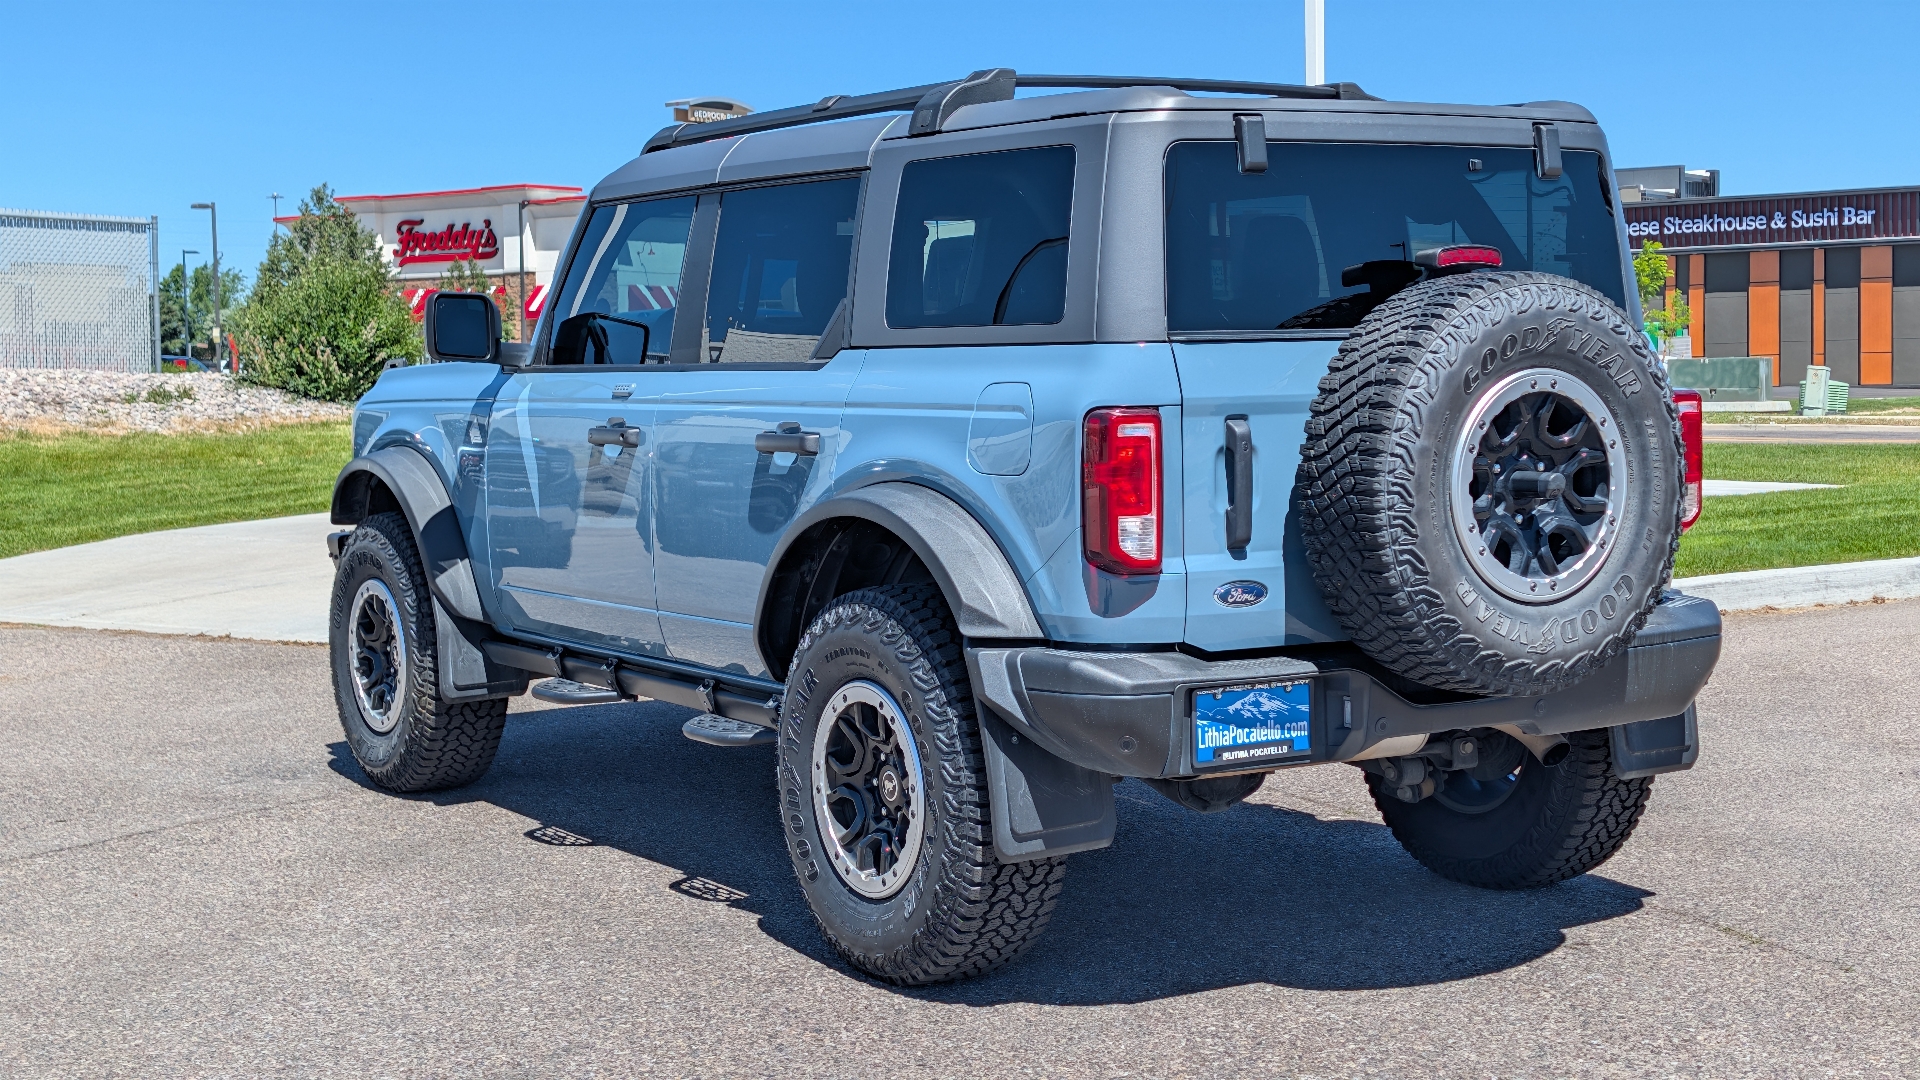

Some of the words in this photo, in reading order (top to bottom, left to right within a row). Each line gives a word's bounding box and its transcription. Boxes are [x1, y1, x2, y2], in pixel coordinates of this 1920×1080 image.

[1663, 214, 1767, 235] Steakhouse
[1770, 211, 1787, 230] &
[1791, 207, 1839, 229] Sushi
[1842, 206, 1876, 226] Bar
[393, 218, 499, 267] Freddy's
[1227, 587, 1257, 602] Ford
[824, 646, 871, 663] TERRITORY
[1198, 719, 1308, 749] LithiaPocatello.com
[1250, 745, 1288, 758] POCATELLO
